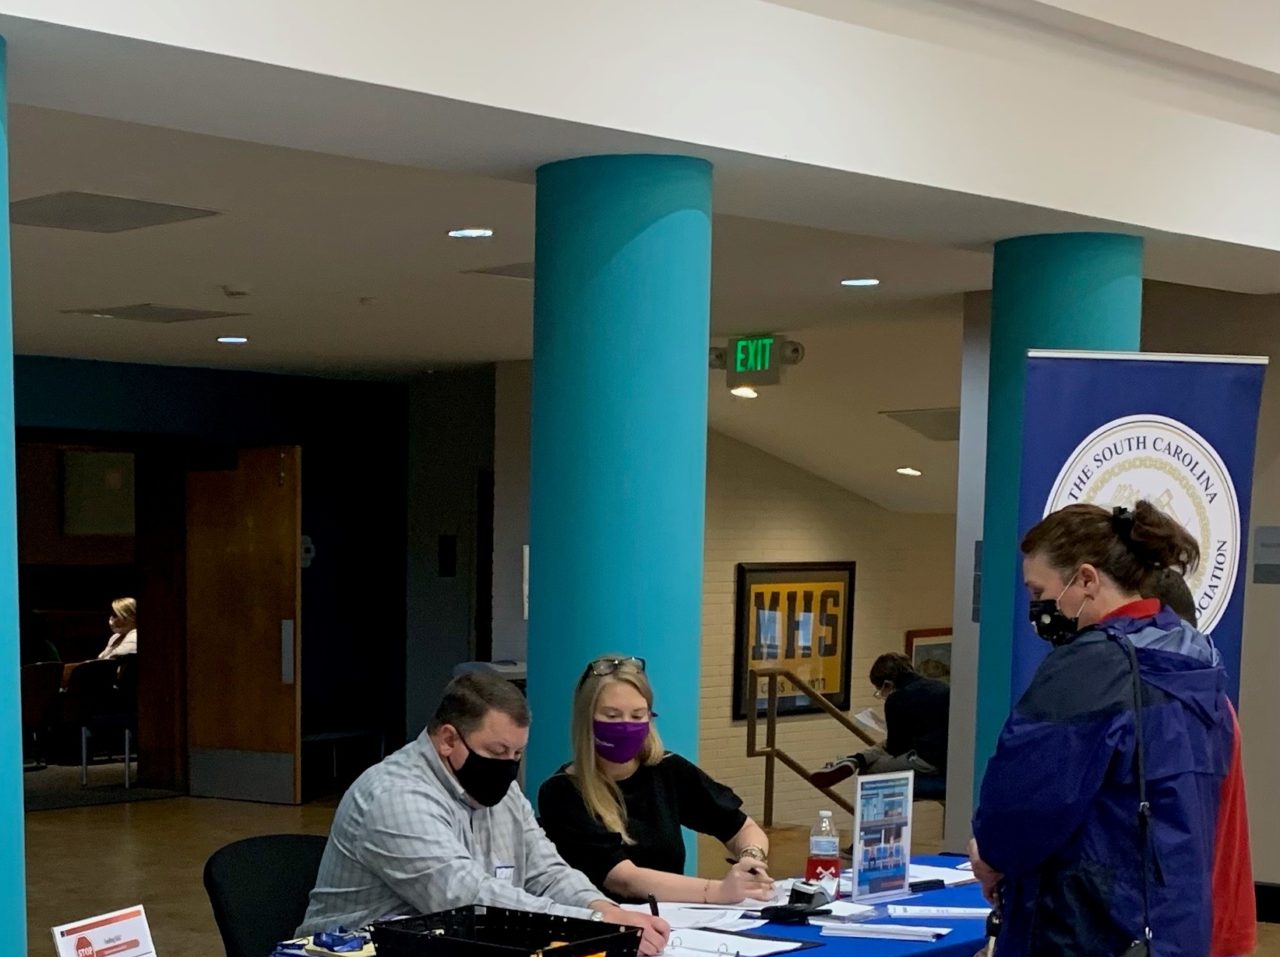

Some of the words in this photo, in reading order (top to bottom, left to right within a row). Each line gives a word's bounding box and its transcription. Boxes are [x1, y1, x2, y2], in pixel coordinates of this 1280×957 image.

[735, 338, 774, 373] EXIT
[1067, 465, 1094, 502] THE
[1093, 436, 1147, 469] SOUTH
[1153, 437, 1219, 504] CAROLINA
[1195, 539, 1228, 620] OCIATION
[751, 590, 840, 661] MHS
[77, 945, 93, 957] STOP
